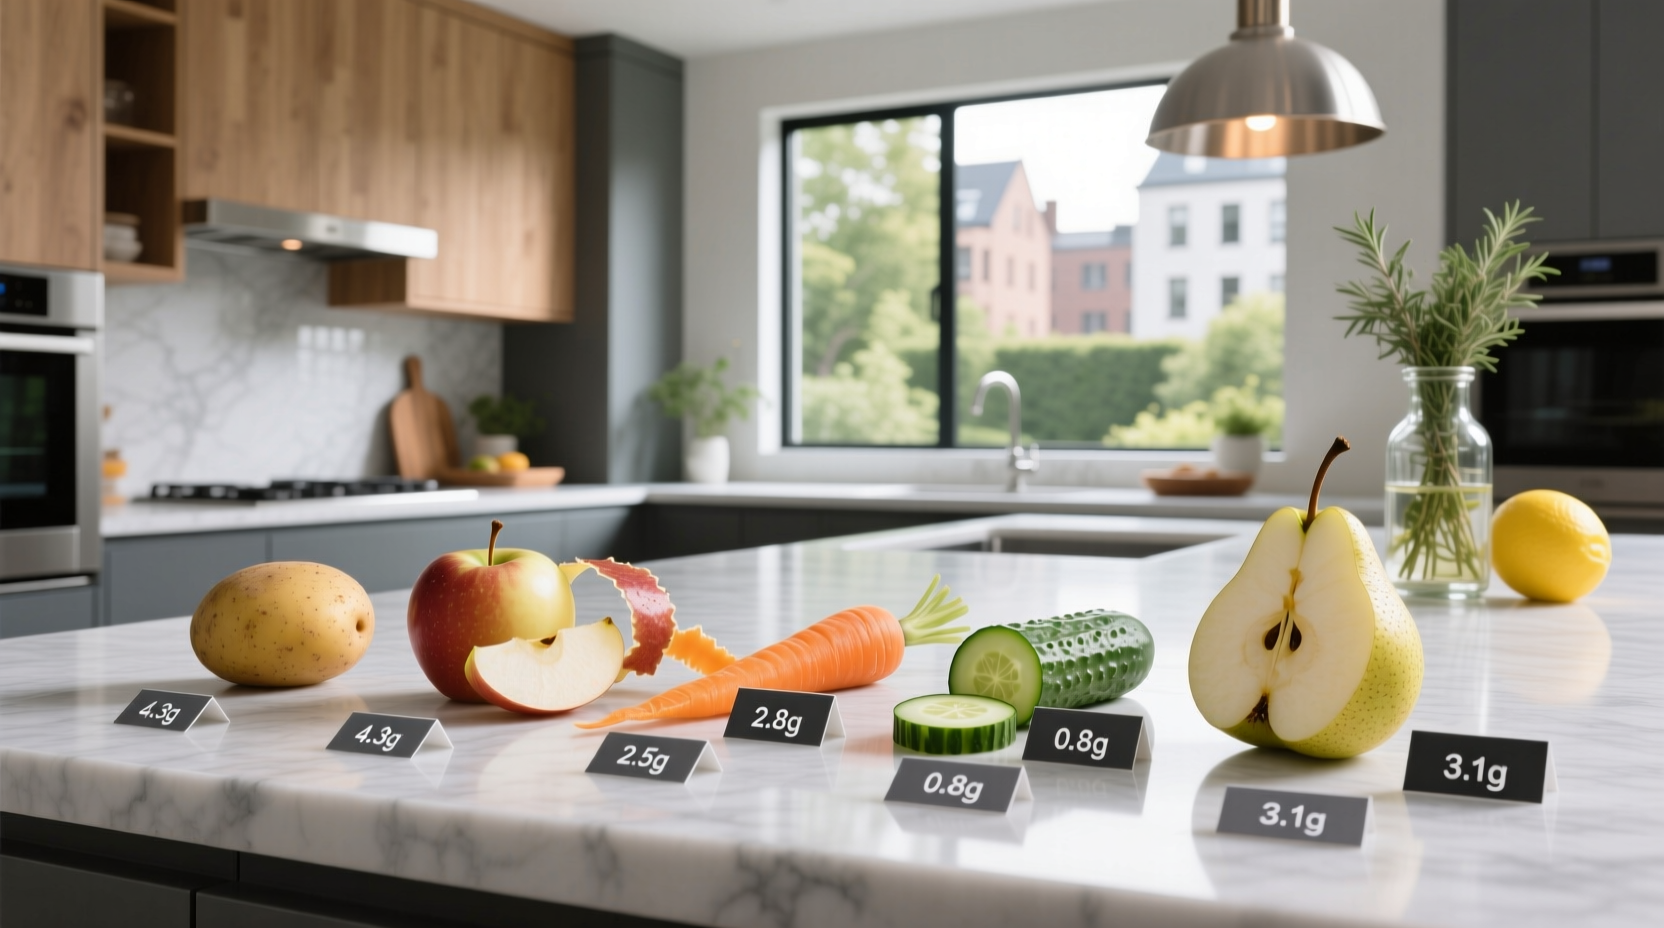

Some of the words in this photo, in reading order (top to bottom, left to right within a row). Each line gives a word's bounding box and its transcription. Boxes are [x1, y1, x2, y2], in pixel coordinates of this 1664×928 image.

[138, 700, 181, 725] 4.3g
[750, 706, 803, 738] 2.8g
[354, 724, 402, 752] 4.3g
[1054, 727, 1109, 761] 0.8g
[616, 744, 671, 776] 2.5g
[1443, 753, 1508, 792] 3.1g
[923, 771, 984, 805] 0.8g
[1258, 801, 1327, 837] 3.1g
